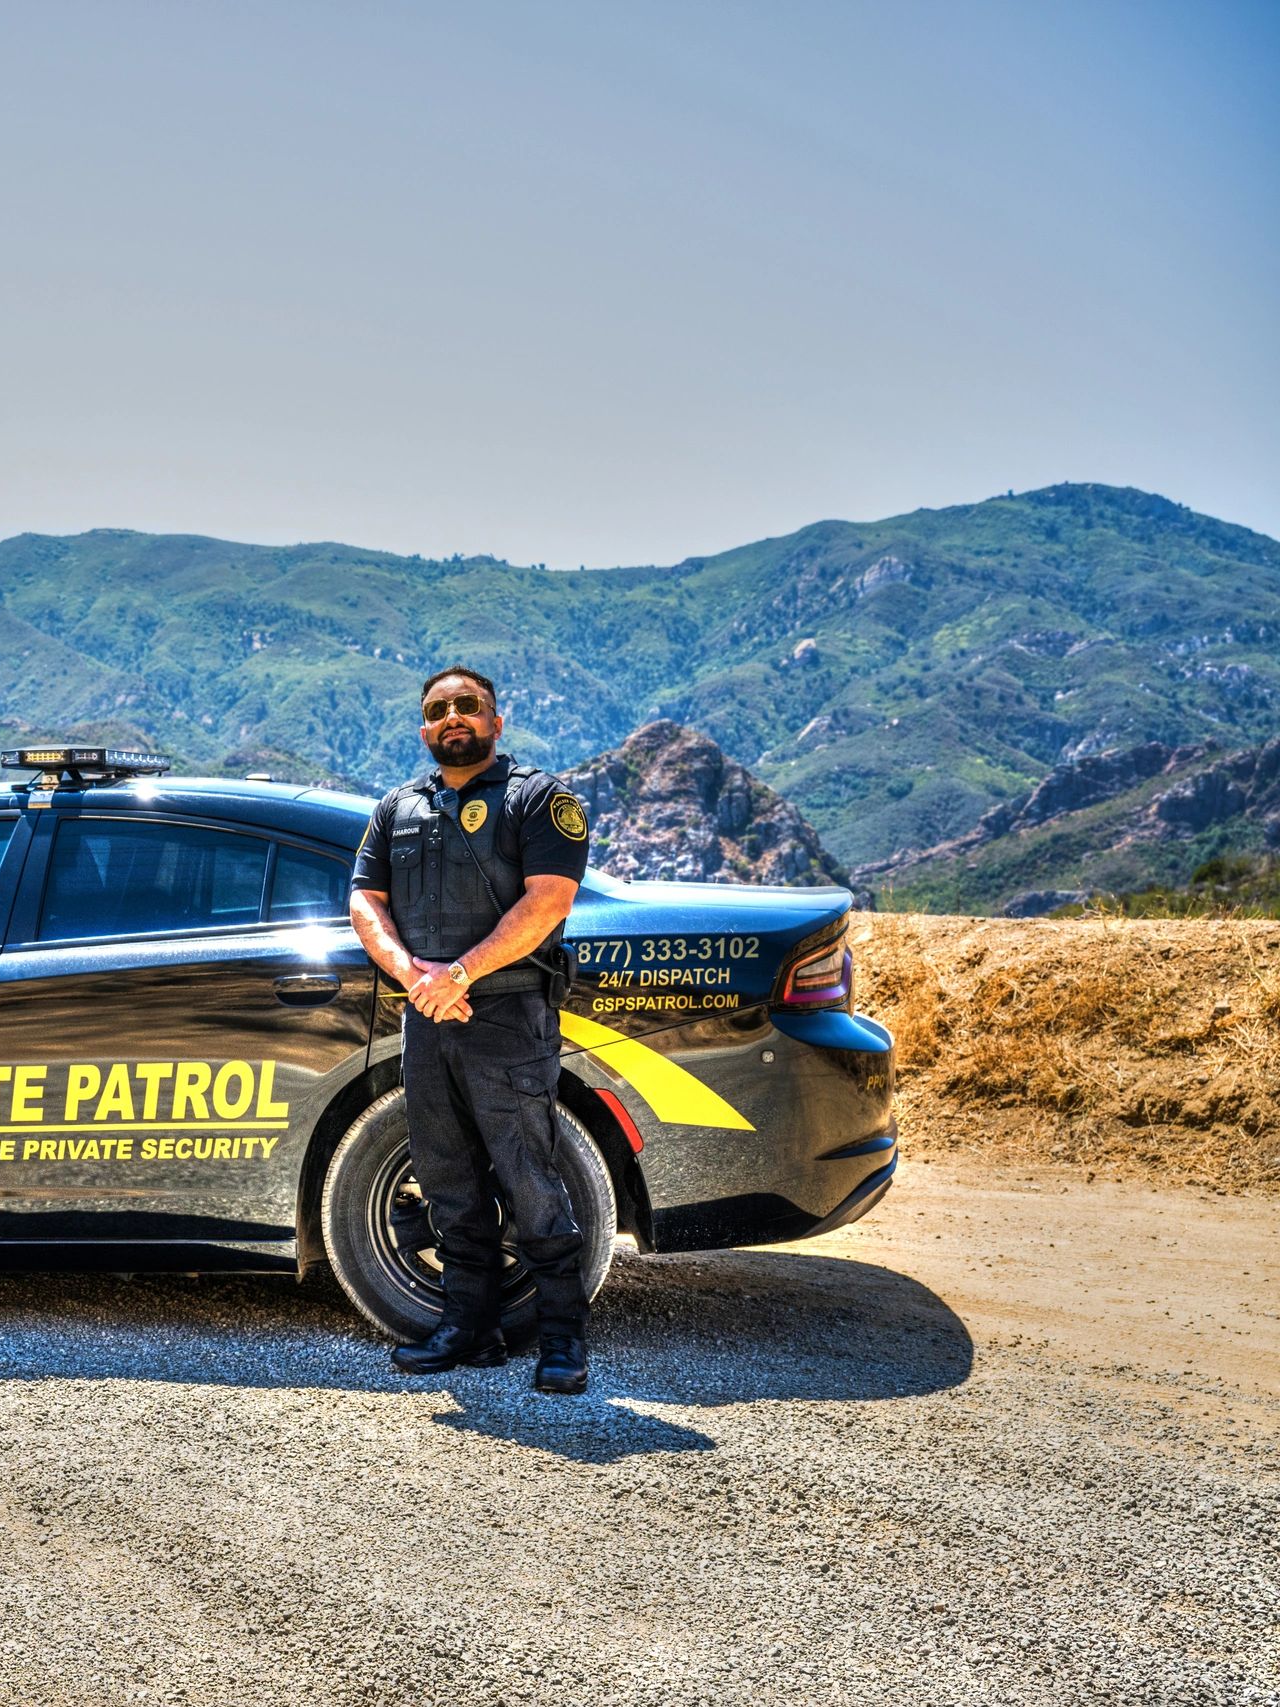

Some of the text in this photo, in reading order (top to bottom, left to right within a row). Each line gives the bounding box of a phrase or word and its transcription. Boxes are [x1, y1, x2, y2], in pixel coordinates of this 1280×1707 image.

[573, 936, 760, 967] 877) 333-3102
[598, 967, 730, 988] 24/7 DISPATCH
[592, 994, 739, 1012] GSPSPATROL.COM
[64, 1060, 290, 1121] PATROL
[23, 1139, 134, 1161] PRIVATE
[141, 1137, 279, 1160] SECURITY
